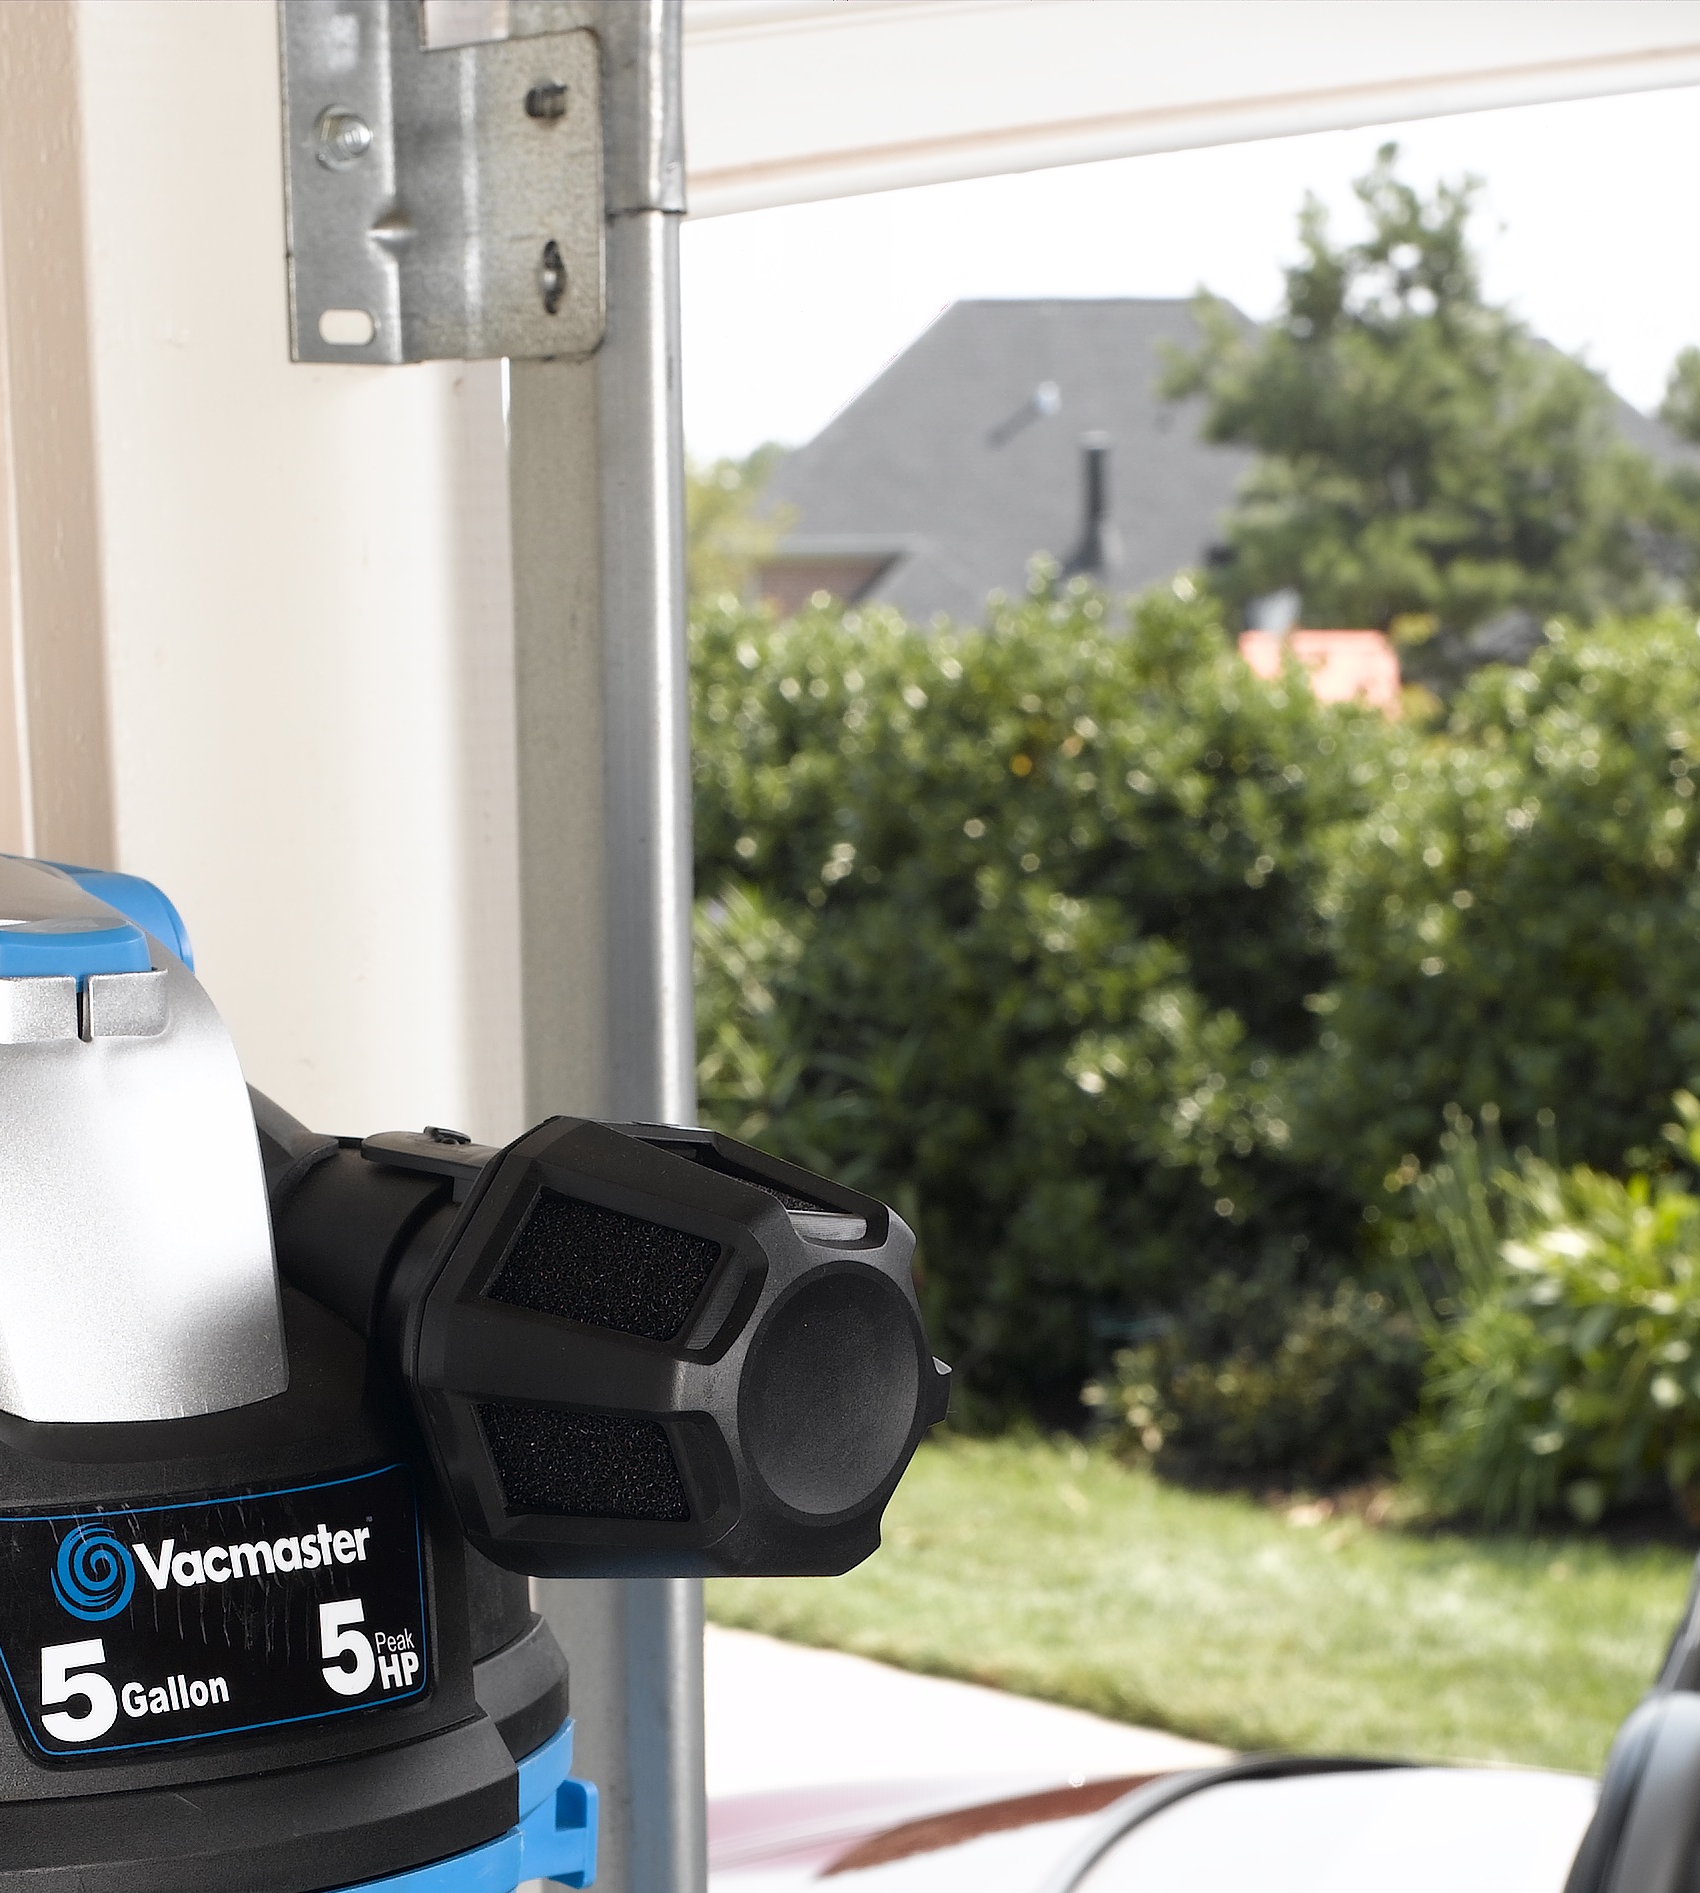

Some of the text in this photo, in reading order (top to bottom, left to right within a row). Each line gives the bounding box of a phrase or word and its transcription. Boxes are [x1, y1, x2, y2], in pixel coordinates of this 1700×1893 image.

[131, 1523, 371, 1591] Vacmaster
[318, 1597, 416, 1697] 5 Peak
[377, 1651, 420, 1691] HP
[40, 1638, 231, 1743] 5 Gallon
